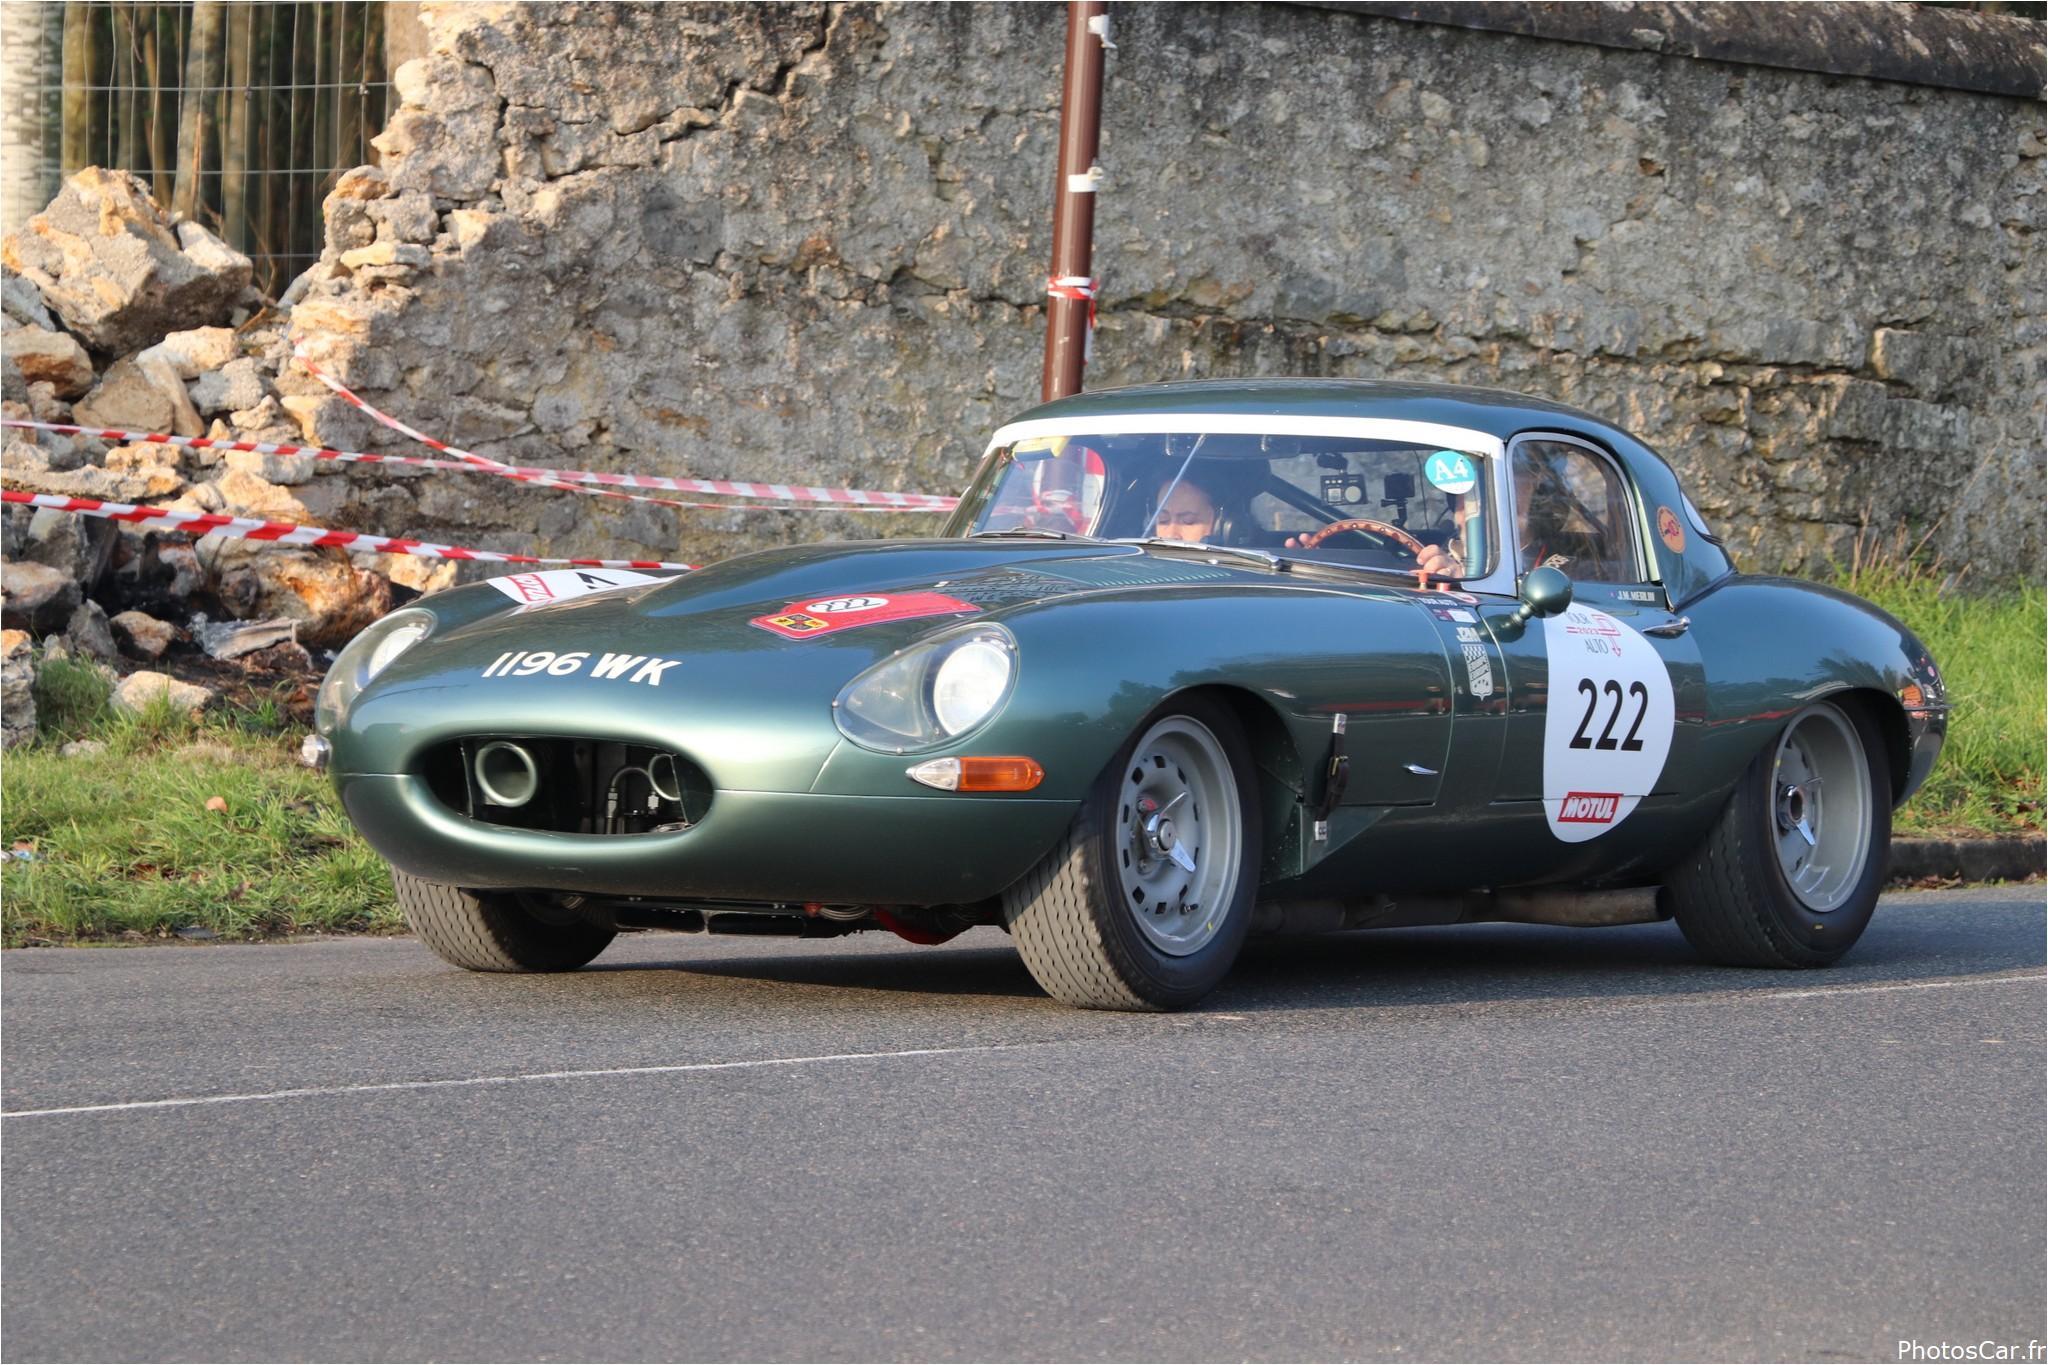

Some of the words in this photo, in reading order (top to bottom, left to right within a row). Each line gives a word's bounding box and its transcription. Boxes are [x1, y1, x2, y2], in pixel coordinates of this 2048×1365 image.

[1434, 457, 1470, 481] A4
[811, 597, 881, 612] 222
[481, 651, 592, 678] 1196
[589, 652, 684, 686] WK
[1568, 677, 1649, 752] 222
[1561, 796, 1615, 819] MOTUL
